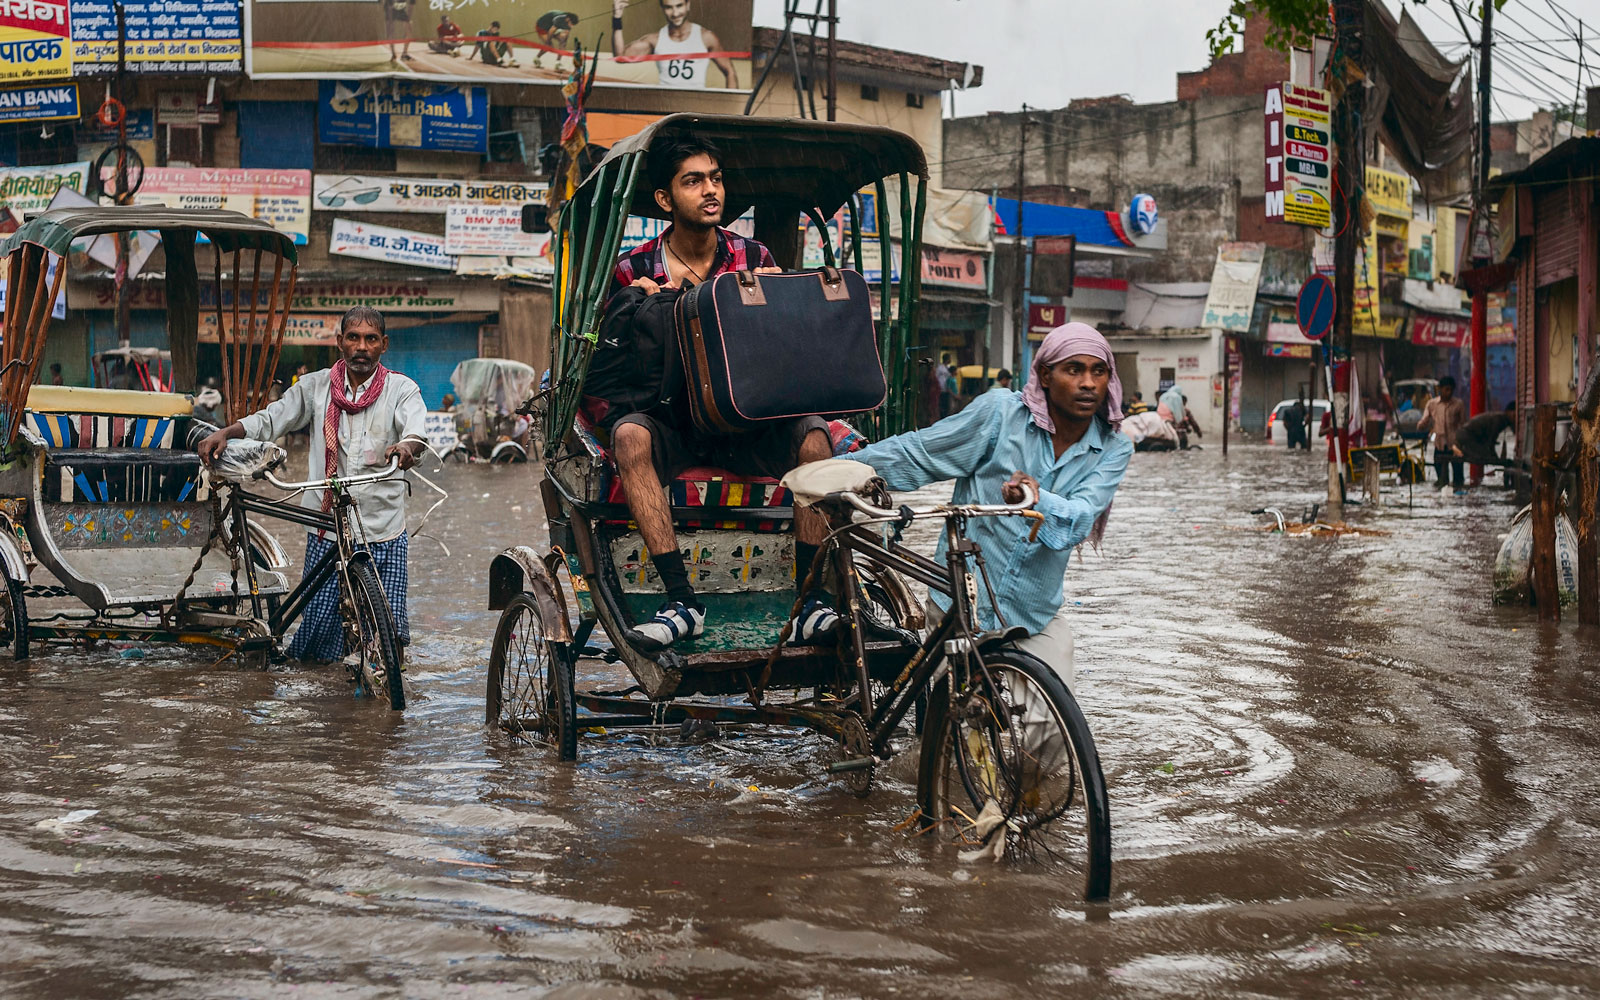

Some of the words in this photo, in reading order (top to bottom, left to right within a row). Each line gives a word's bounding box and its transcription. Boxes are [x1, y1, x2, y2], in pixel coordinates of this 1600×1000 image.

[0, 38, 63, 63] पाठक
[667, 59, 695, 80] 65
[24, 88, 72, 106] BANK
[364, 98, 411, 115] Indian
[415, 100, 453, 117] Bank
[1264, 88, 1284, 217] AITM
[1291, 143, 1324, 160] B.Pharma
[1298, 161, 1317, 175] MBA
[180, 195, 228, 203] FOREIGN
[389, 183, 410, 199] न्यू
[465, 216, 494, 225] BMV
[928, 264, 961, 279] POINT
[348, 285, 429, 297] INDIAN
[407, 295, 455, 306] भोजन
